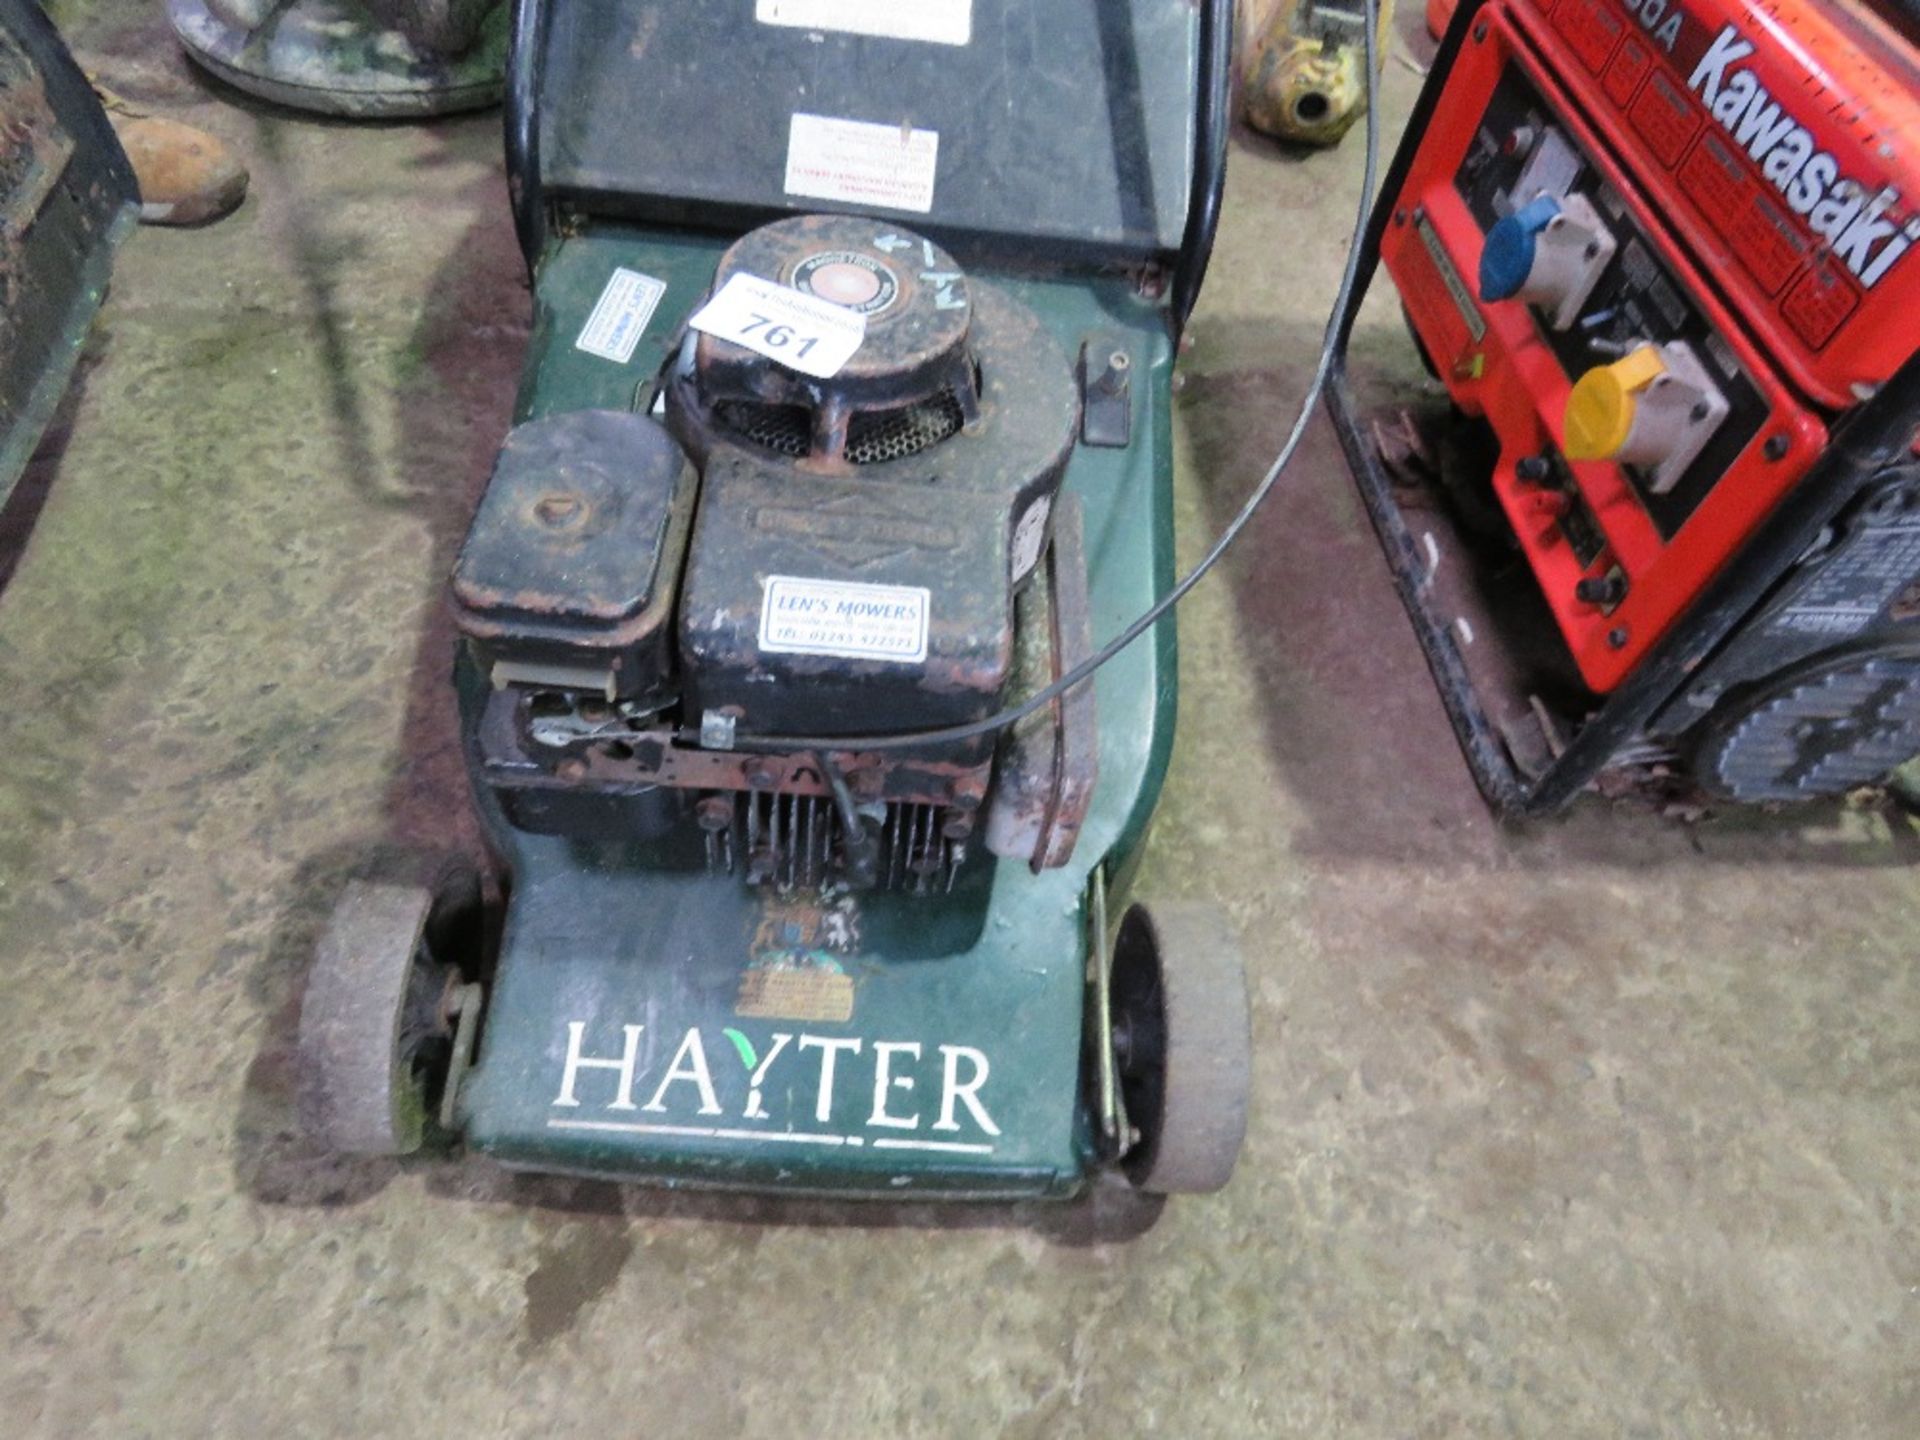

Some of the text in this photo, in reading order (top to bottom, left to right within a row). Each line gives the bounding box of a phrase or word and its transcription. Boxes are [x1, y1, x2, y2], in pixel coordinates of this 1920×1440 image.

[1687, 25, 1920, 289] Kawasaki
[738, 313, 820, 359] 761
[778, 595, 917, 620] LEN'S MOWERS
[552, 1021, 1002, 1136] HAYTER
